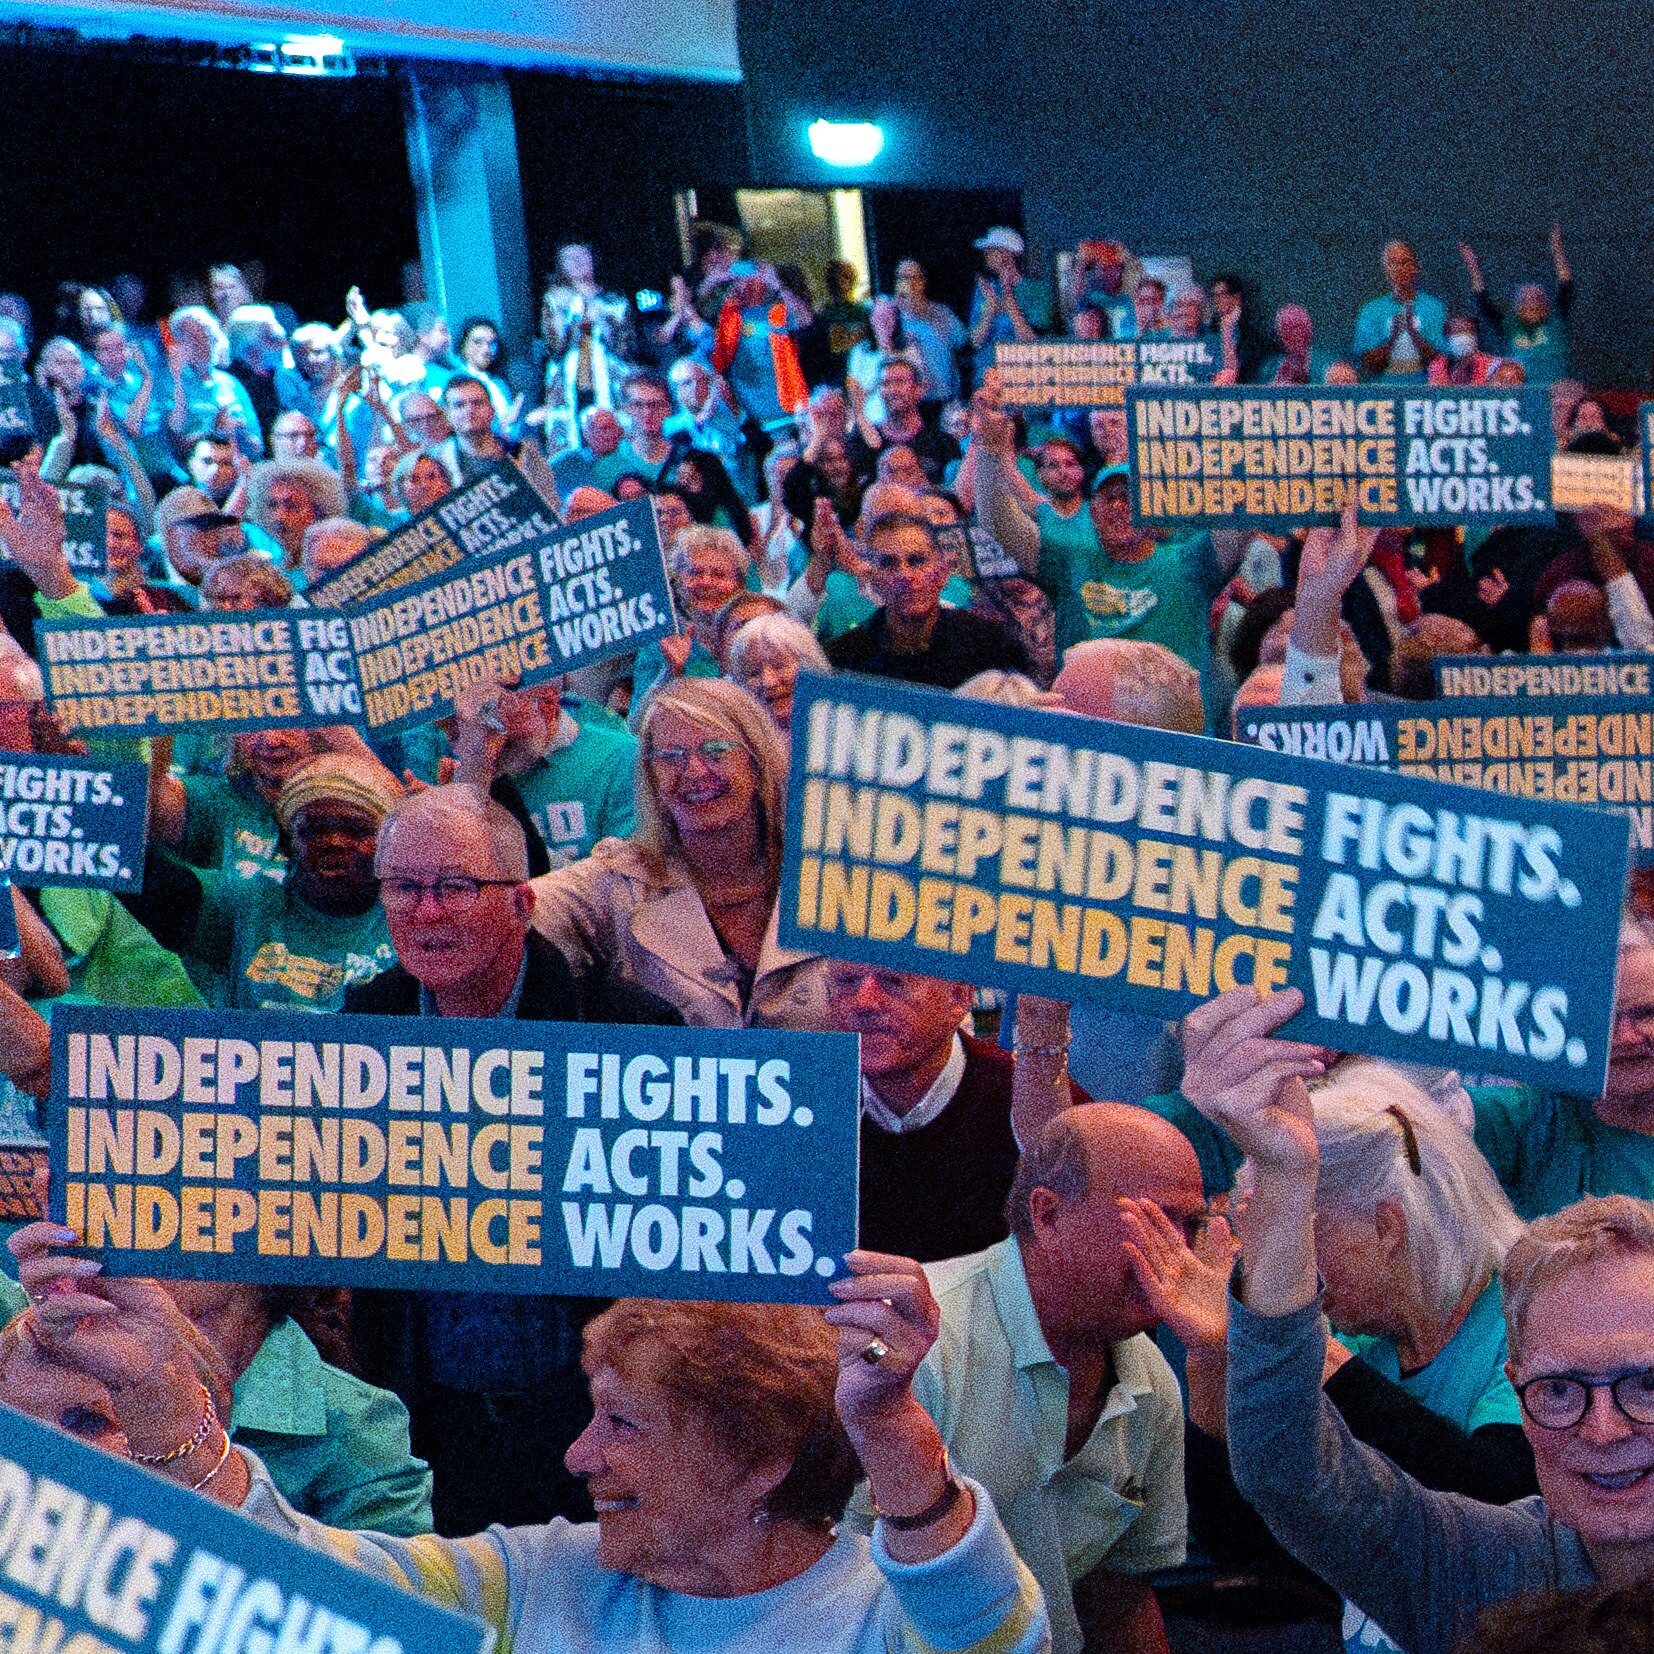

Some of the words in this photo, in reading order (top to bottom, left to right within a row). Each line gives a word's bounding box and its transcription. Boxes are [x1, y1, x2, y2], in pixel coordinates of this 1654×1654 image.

[1135, 399, 1397, 436] INDEPENDENCE
[1405, 399, 1534, 435] FIGHTS.
[1137, 438, 1398, 476] INDEPENDENCE
[1406, 438, 1500, 474] ACTS.
[438, 475, 517, 531] FIGHTS.
[459, 508, 517, 552] ACTS.
[1138, 477, 1398, 516] INDEPENDENCE
[1406, 476, 1547, 512] WORKS.
[350, 554, 538, 653] INDEPENDENCE
[538, 520, 640, 585] FIGHTS.
[44, 621, 293, 663] INDEPENDENCE
[357, 592, 545, 691] INDEPENDENCE
[549, 568, 621, 624] ACTS.
[364, 630, 552, 728] INDEPENDENCE
[551, 593, 663, 660] WORKS.
[49, 653, 296, 696] INDEPENDENCE
[54, 686, 300, 729] INDEPENDENCE
[1441, 666, 1650, 696] INDEPENDENCE
[806, 699, 1309, 856] INDEPENDENCE
[1322, 793, 1583, 906] FIGHTS.
[802, 779, 1299, 931] INDEPENDENCE
[1313, 879, 1503, 971] ACTS.
[798, 859, 1294, 999] INDEPENDENCE
[1309, 945, 1589, 1067] WORKS.
[67, 1033, 545, 1117] INDEPENDENCE
[564, 1051, 813, 1127] FIGHTS.
[66, 1107, 544, 1191] INDEPENDENCE
[562, 1127, 744, 1199] ACTS.
[66, 1181, 543, 1266] INDEPENDENCE
[562, 1201, 835, 1278] WORKS.
